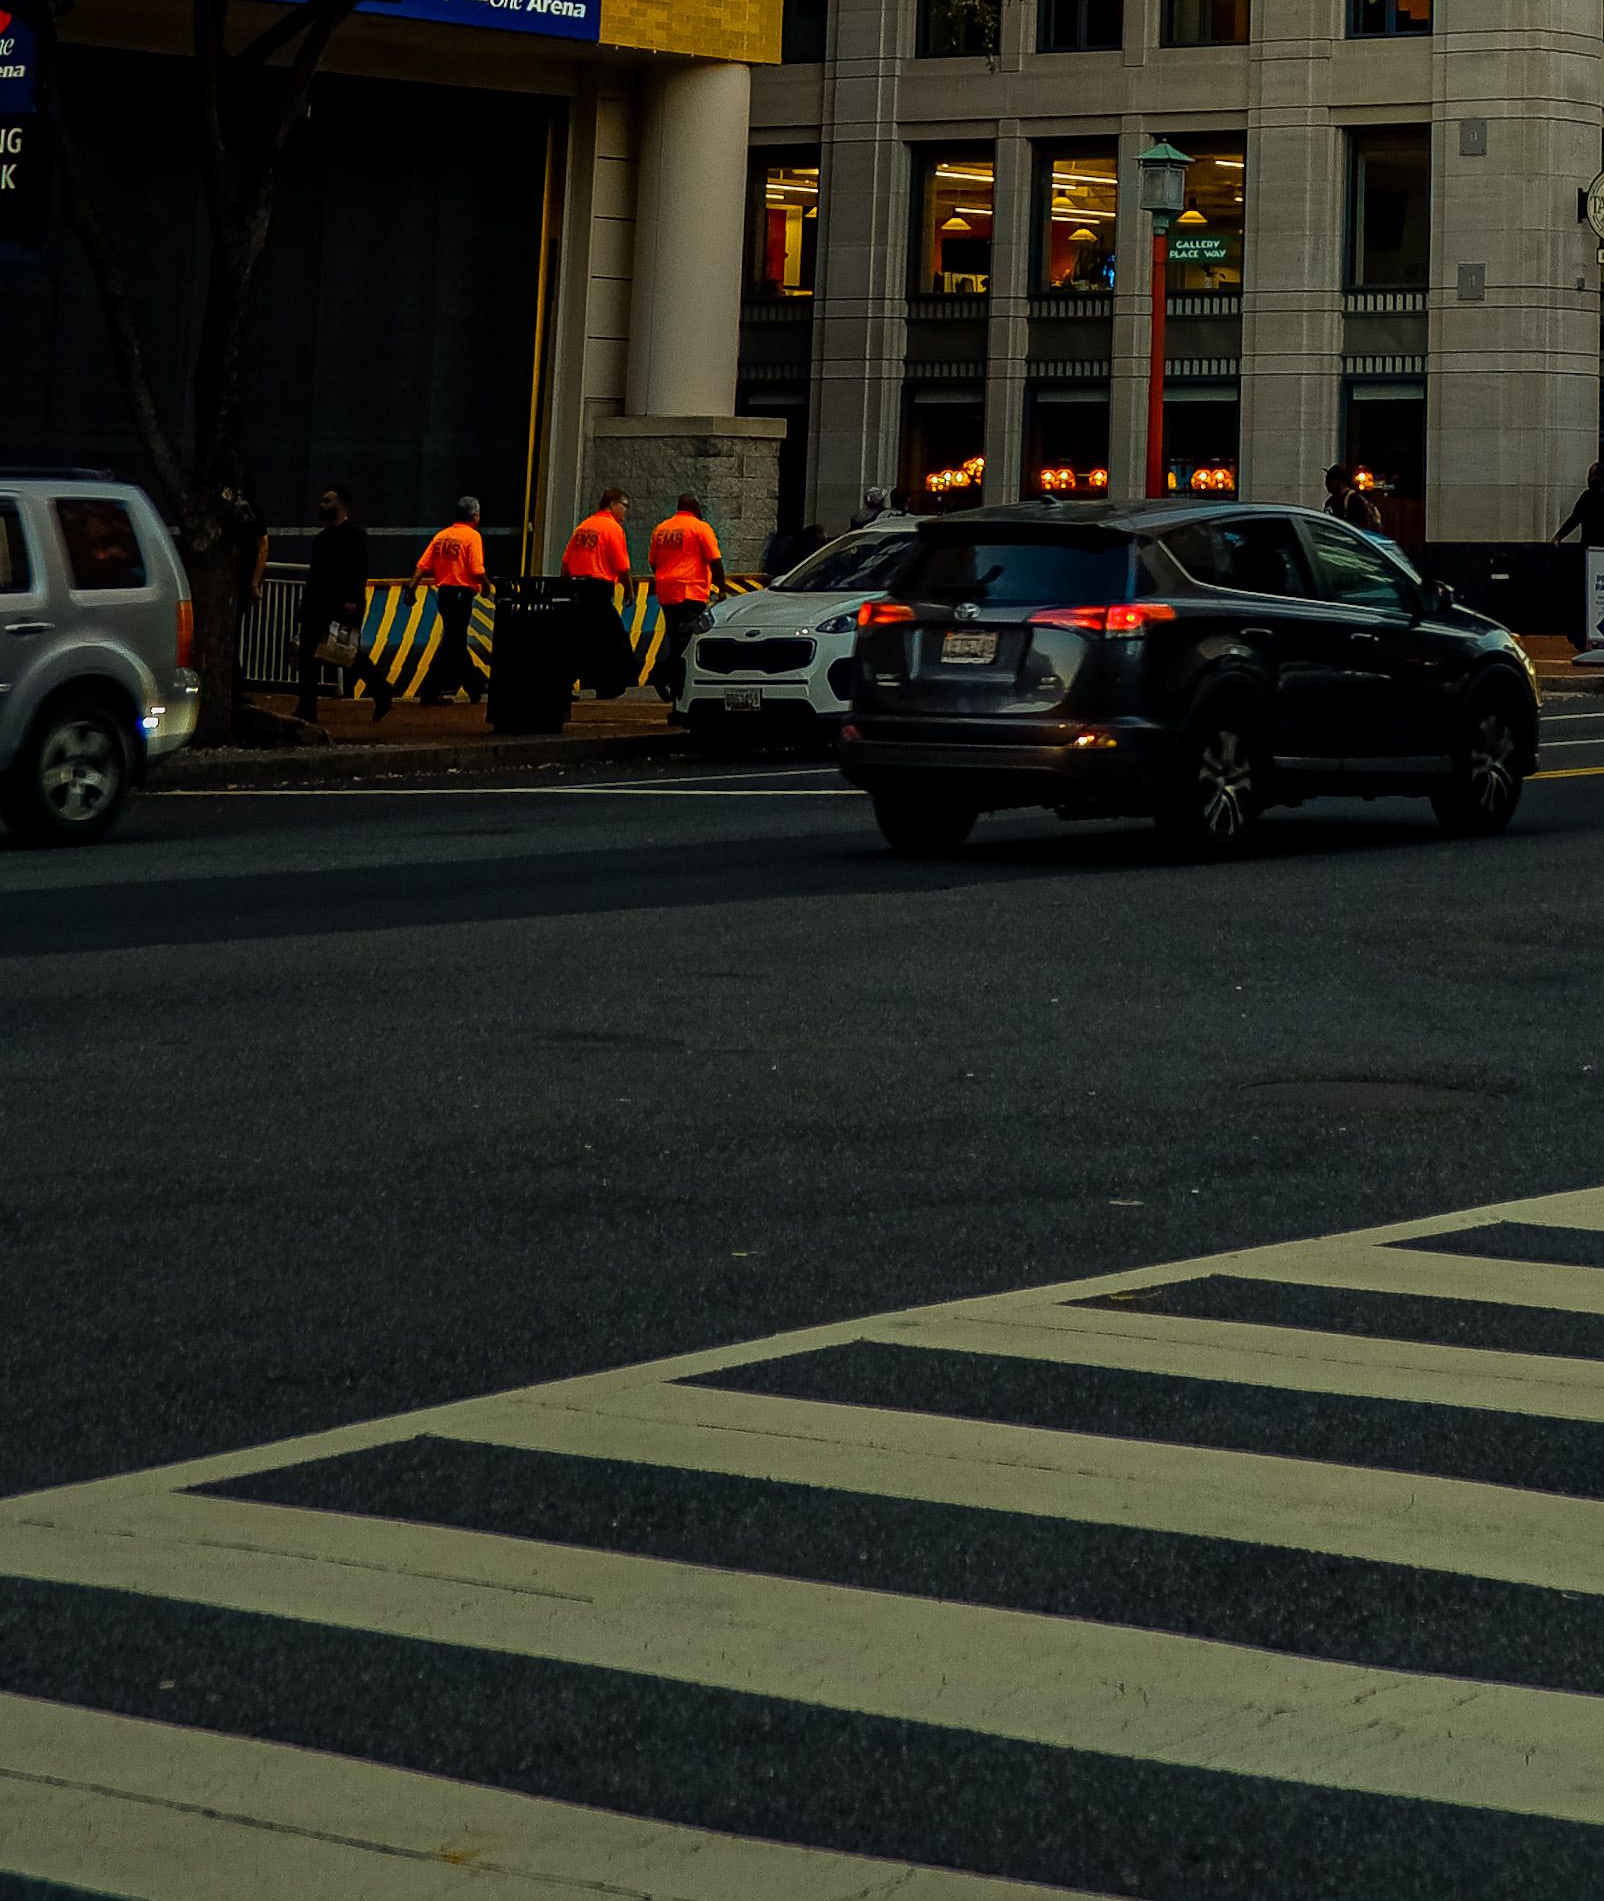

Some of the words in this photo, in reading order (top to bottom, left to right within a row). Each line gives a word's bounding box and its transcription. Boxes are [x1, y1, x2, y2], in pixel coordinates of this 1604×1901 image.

[1175, 239, 1221, 249] GALLERY
[1169, 249, 1200, 259] PLACE
[1203, 249, 1227, 258] WAY
